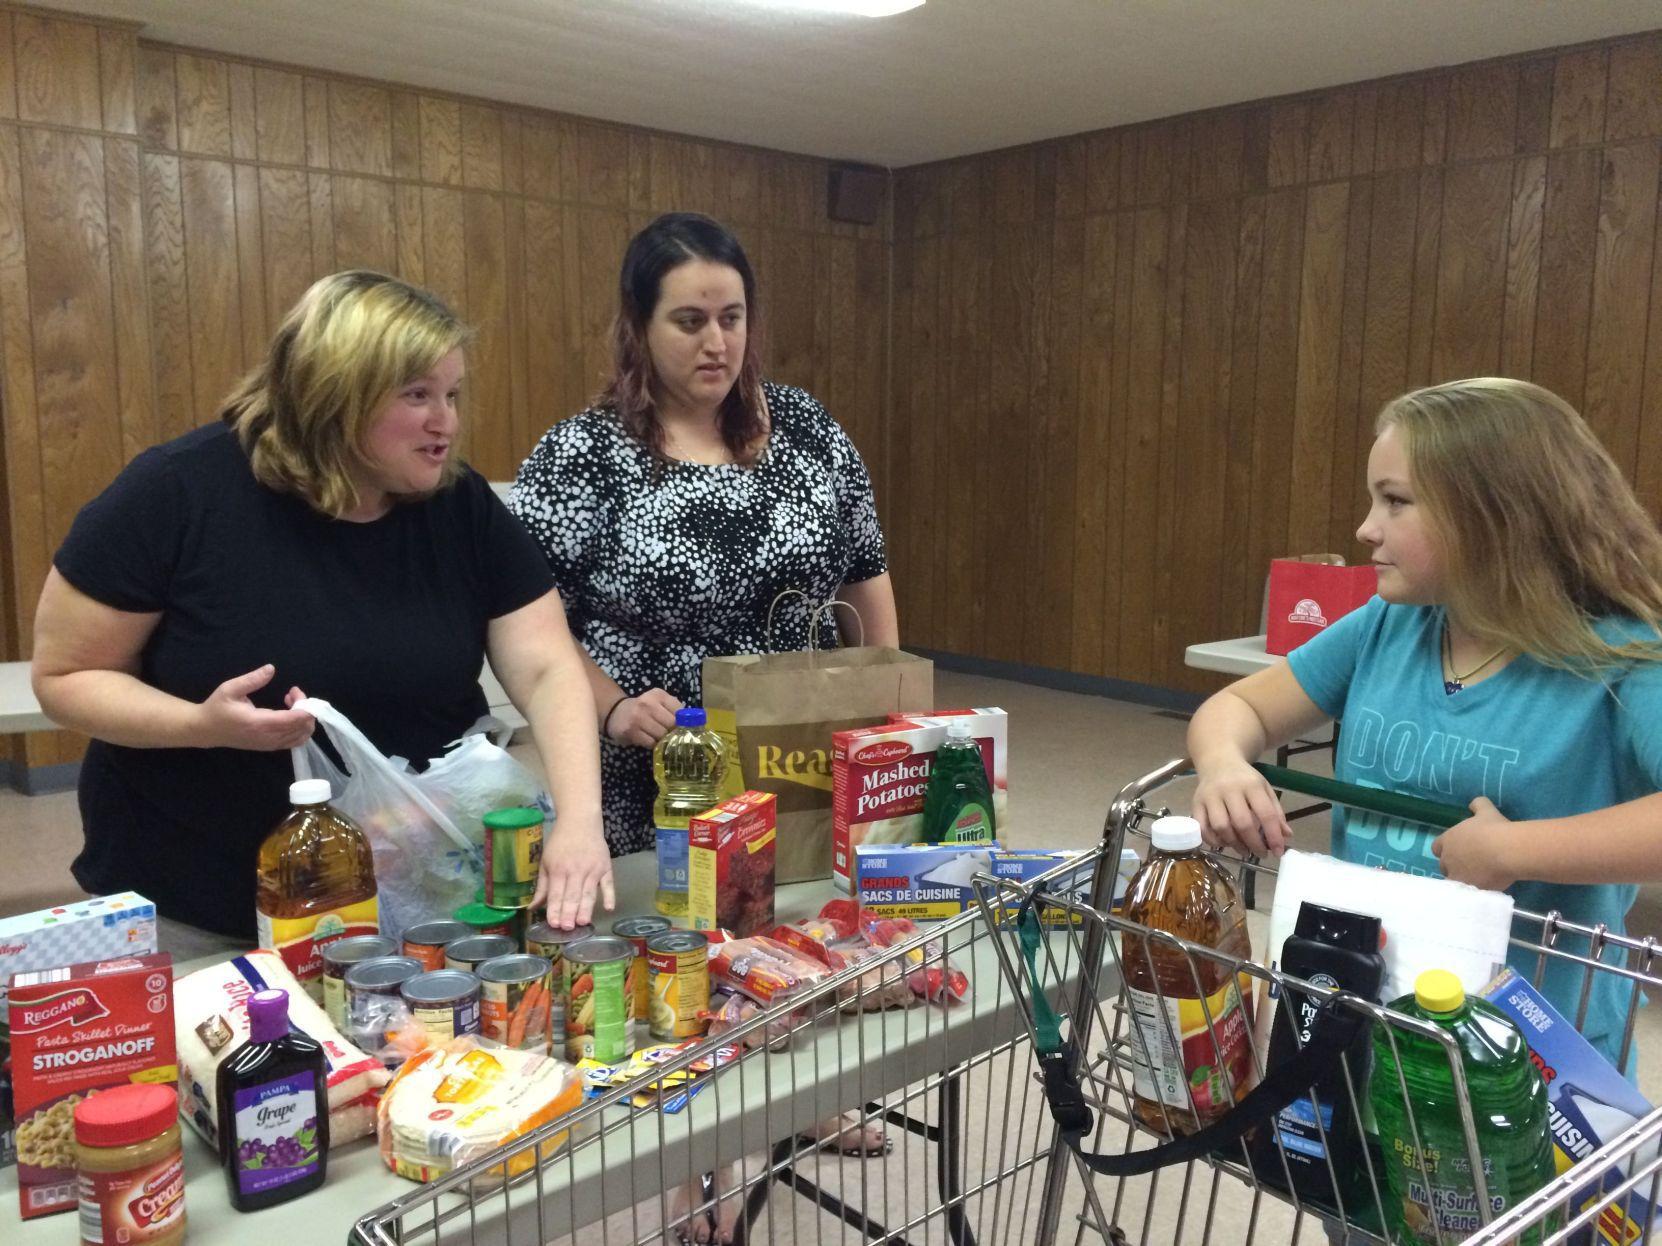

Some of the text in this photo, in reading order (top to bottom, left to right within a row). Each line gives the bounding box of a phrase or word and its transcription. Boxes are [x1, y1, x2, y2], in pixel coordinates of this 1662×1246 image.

[757, 745, 834, 778] Rea
[1347, 707, 1520, 806] DON'T
[862, 759, 930, 794] Mashed
[861, 876, 910, 890] GRANDS
[862, 888, 961, 902] SACS DE CUISINE
[151, 979, 161, 988] 10
[24, 995, 86, 1025] REGGANO
[1508, 994, 1549, 1034] STORE
[1524, 996, 1554, 1030] HOME
[36, 1021, 152, 1048] Pasta Skillet Dinner
[33, 1036, 155, 1070] STROGANOFF
[260, 1085, 290, 1099] PAMPA
[1547, 1100, 1597, 1159] CUISIN
[138, 1177, 184, 1217] Cream
[1409, 1182, 1505, 1213] Muti-Surfe
[1433, 1206, 1484, 1232] leane
